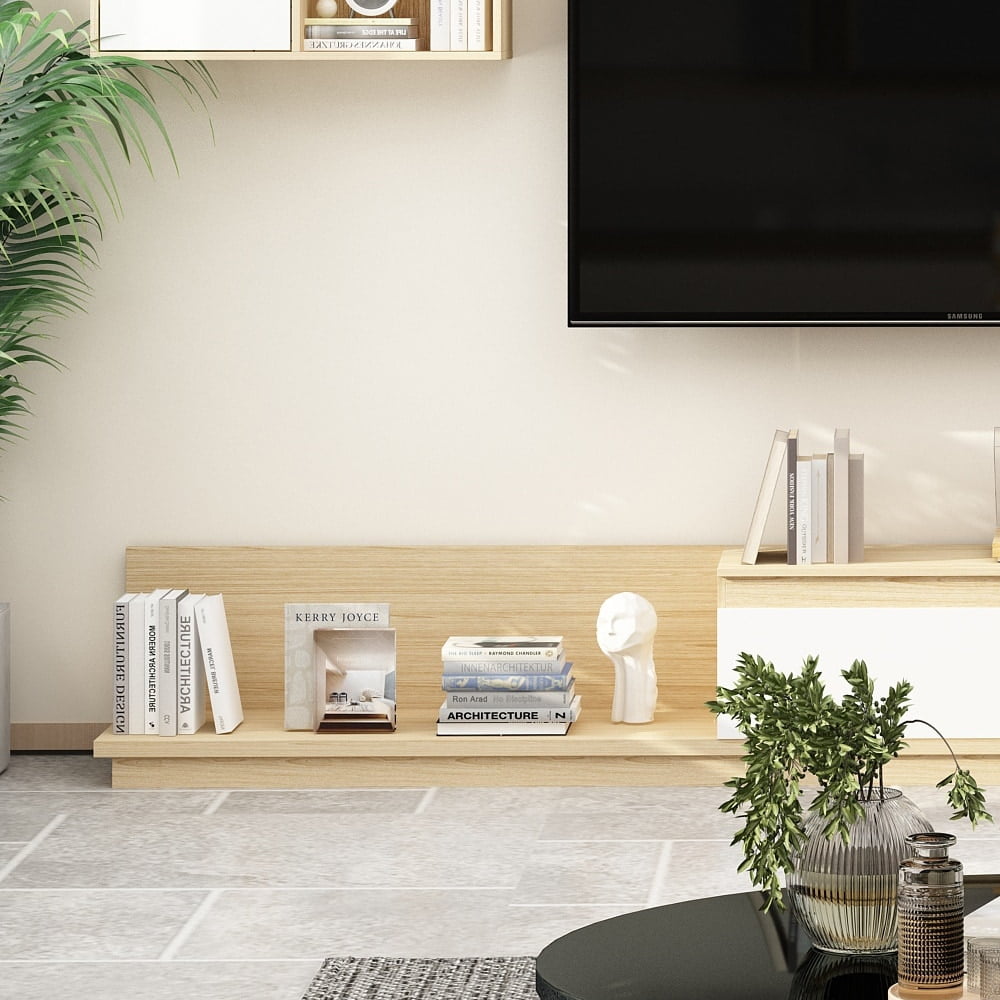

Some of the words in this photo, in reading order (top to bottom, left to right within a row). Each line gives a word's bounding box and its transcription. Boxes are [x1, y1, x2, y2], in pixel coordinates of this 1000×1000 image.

[947, 312, 983, 320] SAMSUNG
[295, 612, 336, 623] KERRY
[341, 612, 379, 623] JOYCE
[461, 662, 553, 673] INNENARCHITEKTUR
[452, 695, 468, 703] Ron
[470, 695, 488, 703] Arad
[447, 711, 539, 720] ARCHITECTURE
